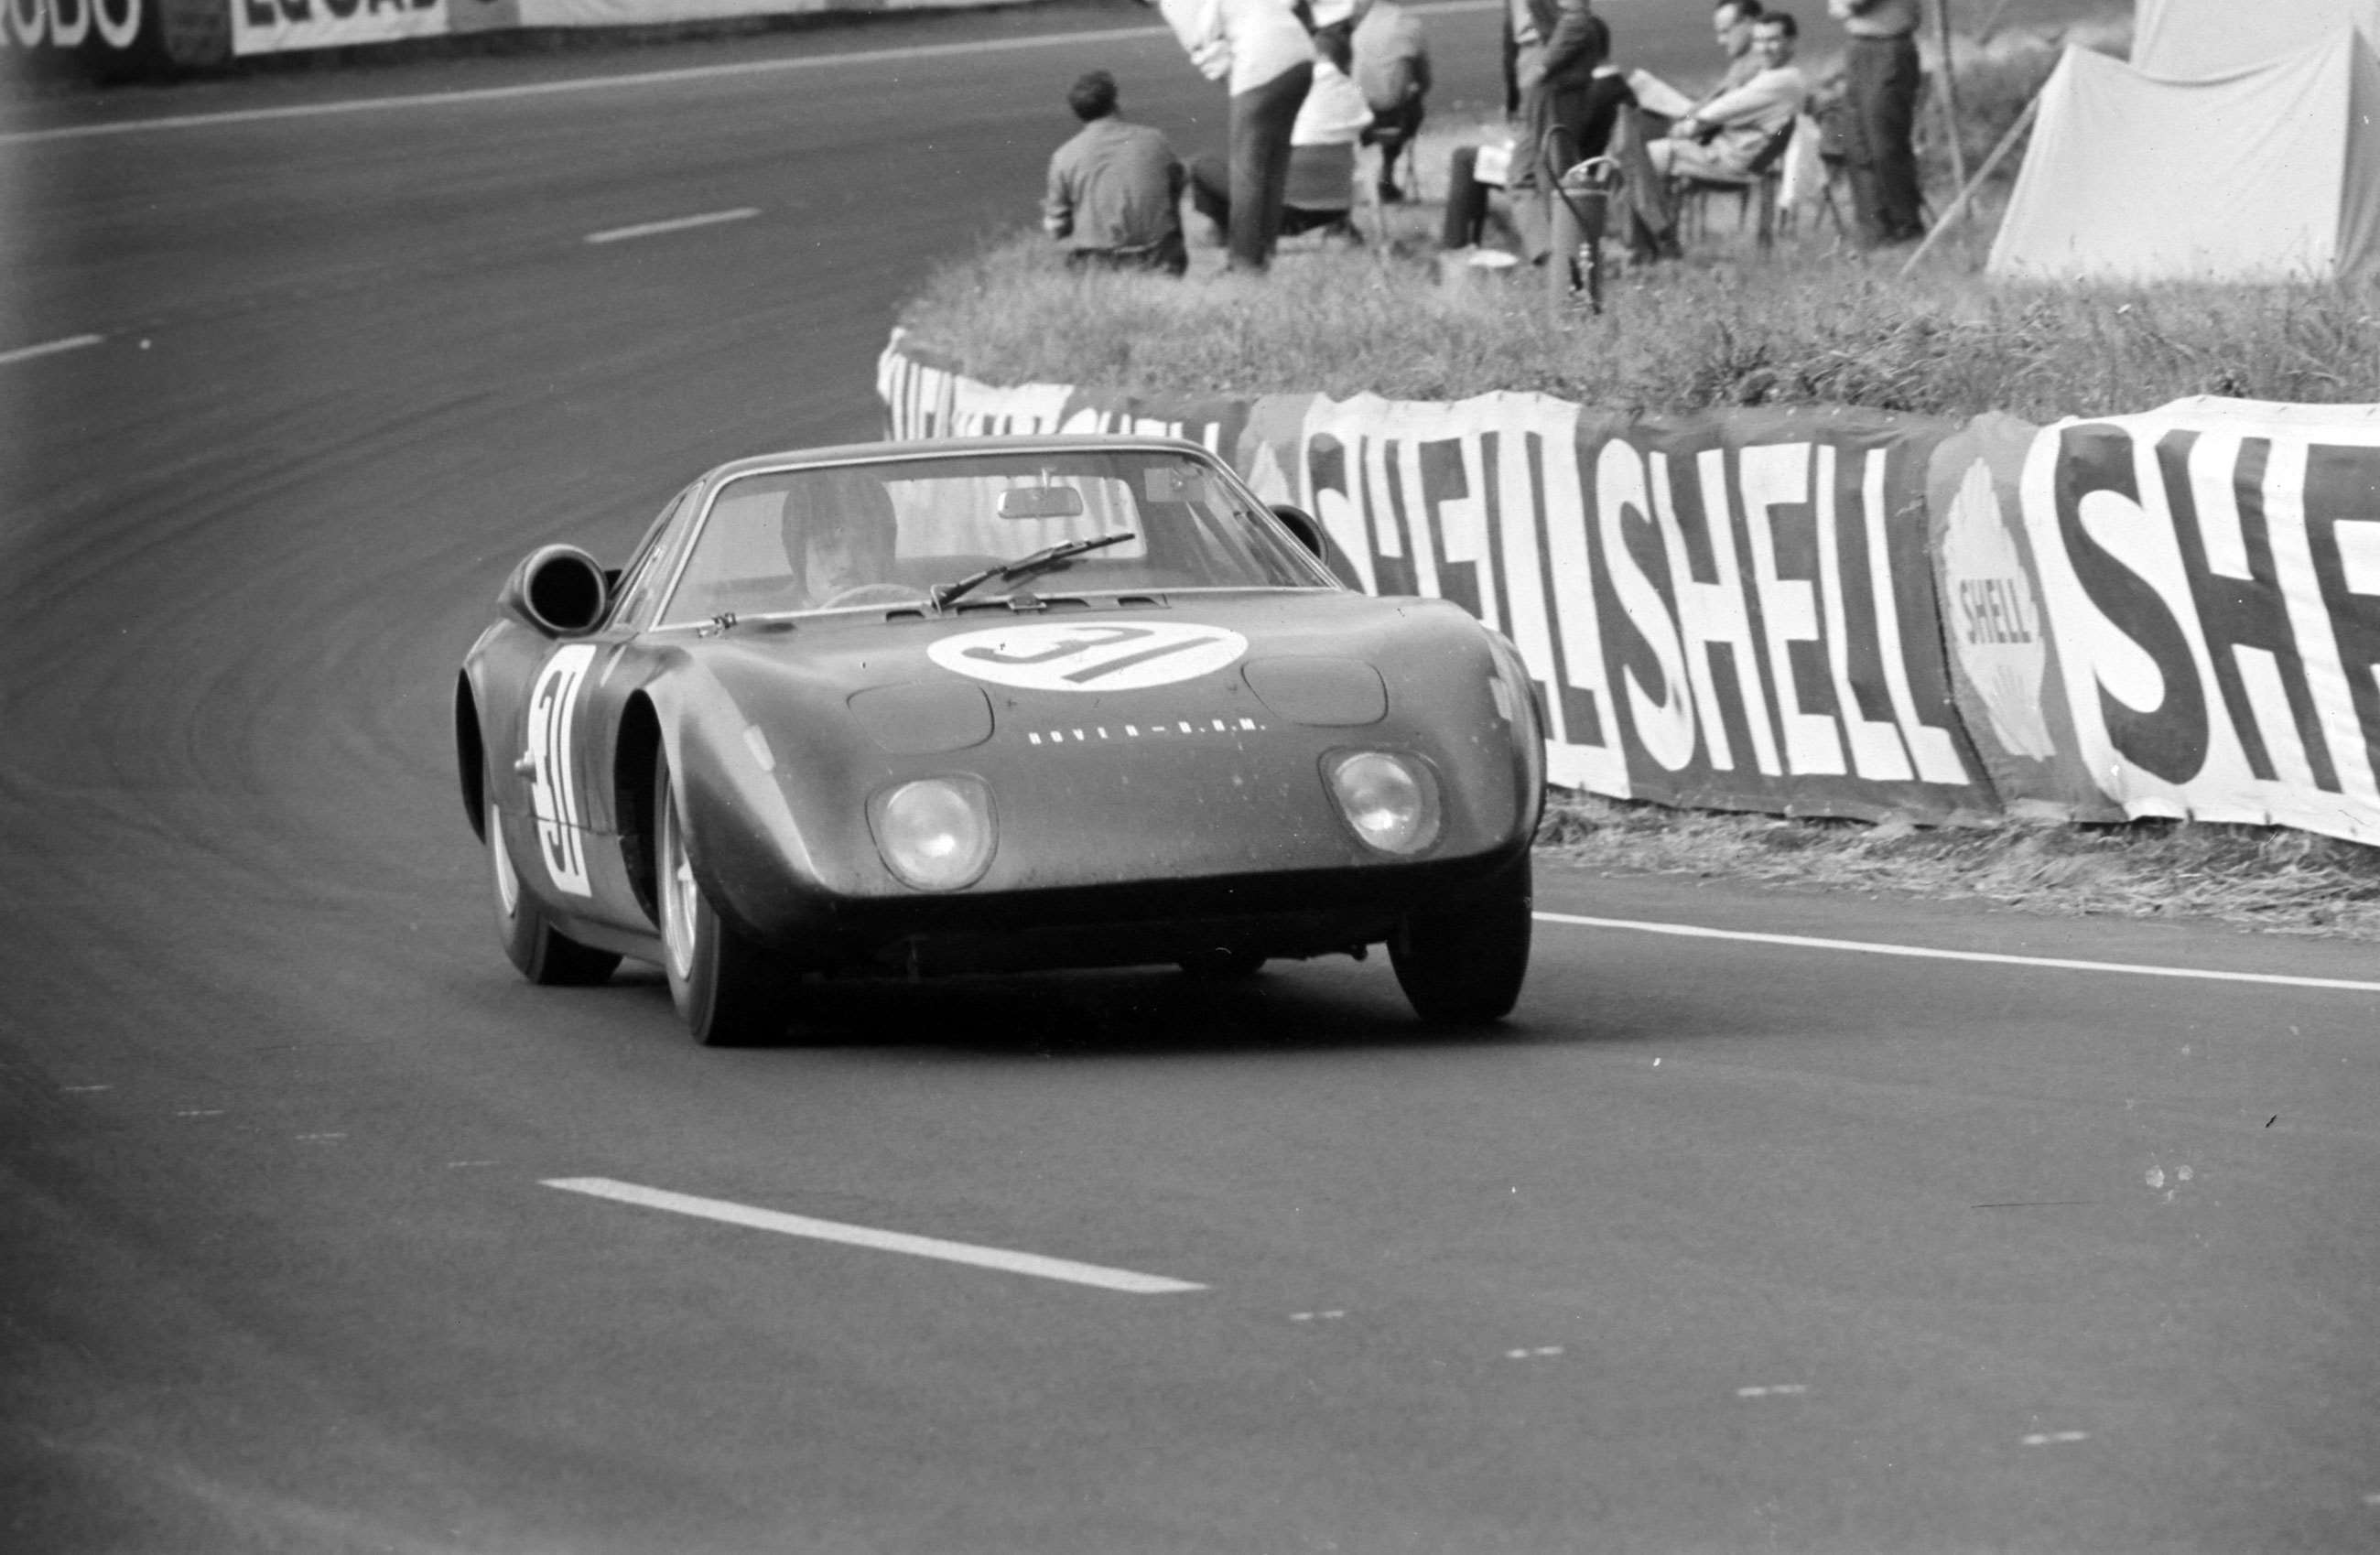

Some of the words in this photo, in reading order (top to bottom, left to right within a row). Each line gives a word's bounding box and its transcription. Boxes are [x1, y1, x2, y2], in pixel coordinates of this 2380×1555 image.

[961, 626, 1221, 684] 31
[1596, 437, 1970, 786] SHELL
[1960, 578, 2032, 644] SHELL
[536, 668, 579, 877] 31
